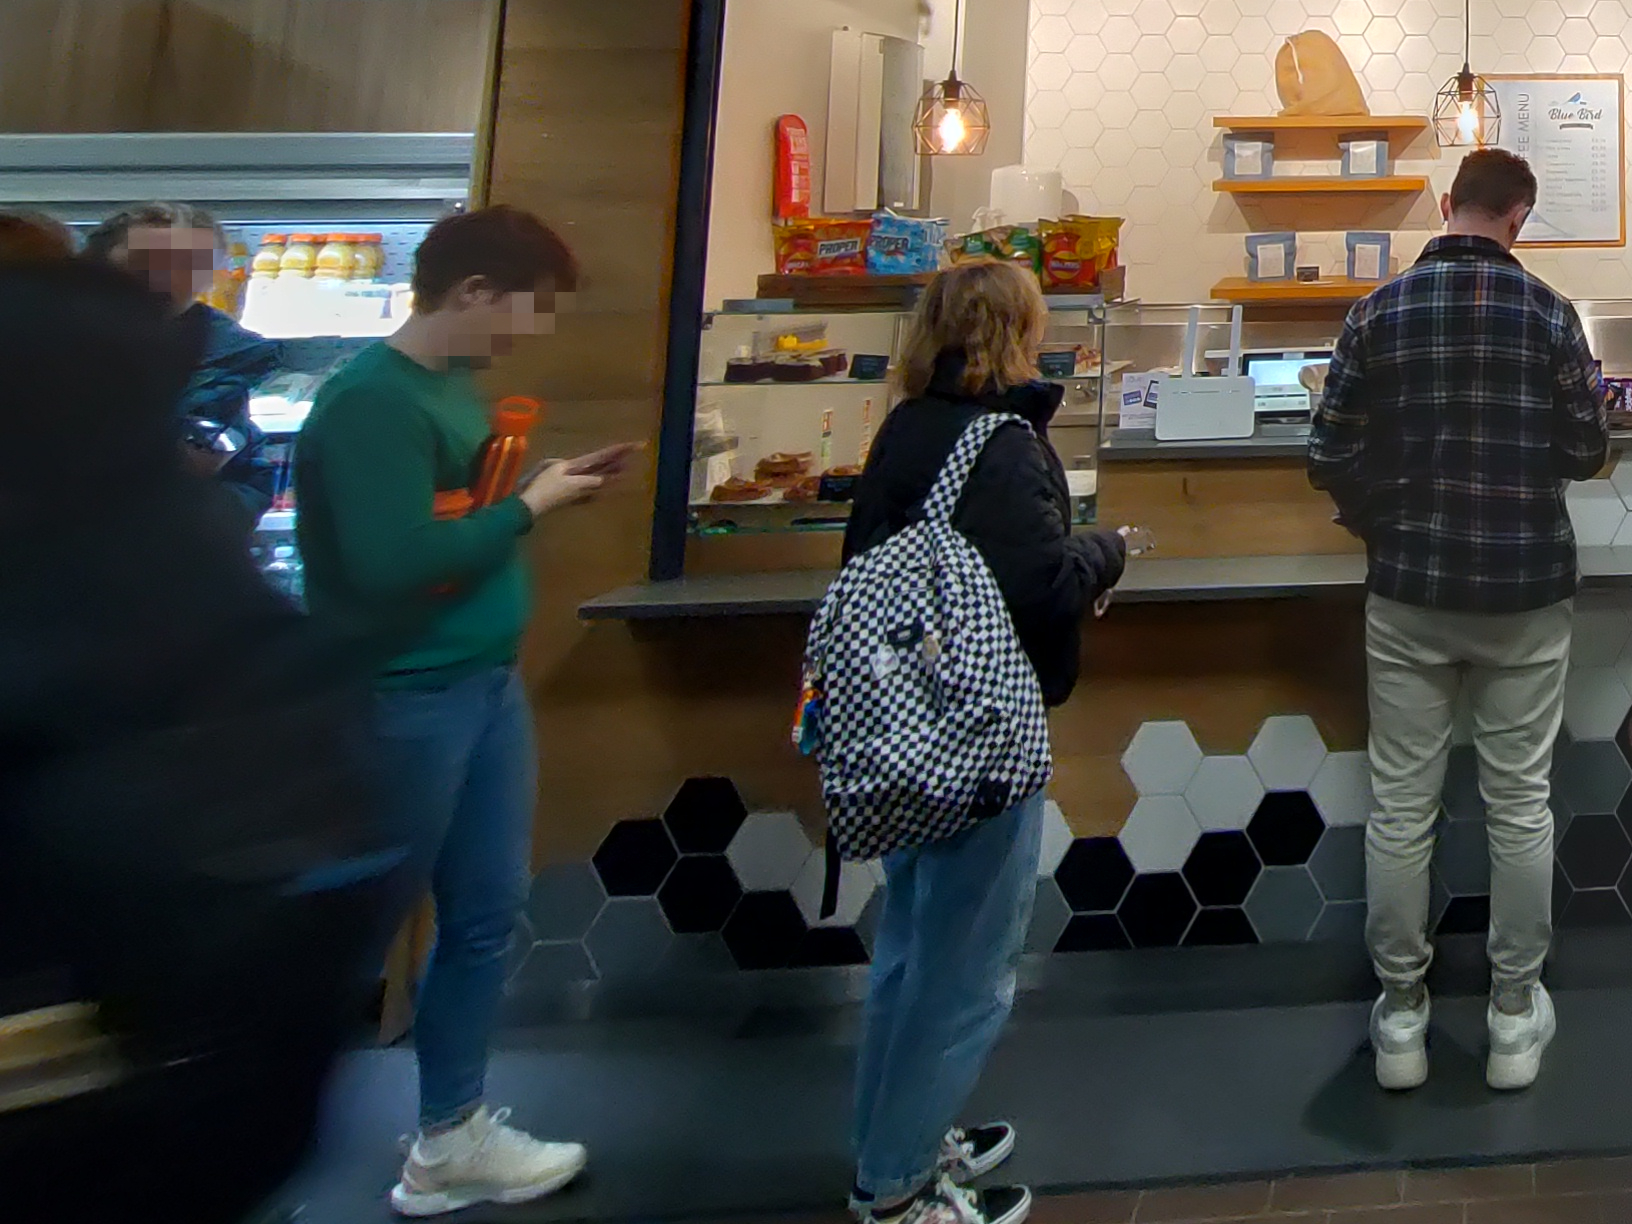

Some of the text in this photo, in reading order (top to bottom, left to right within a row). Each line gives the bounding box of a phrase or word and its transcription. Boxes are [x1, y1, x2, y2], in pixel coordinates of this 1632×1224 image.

[1517, 93, 1530, 132] MENU
[1548, 107, 1603, 121] Blue Bird
[818, 239, 859, 256] PROPER
